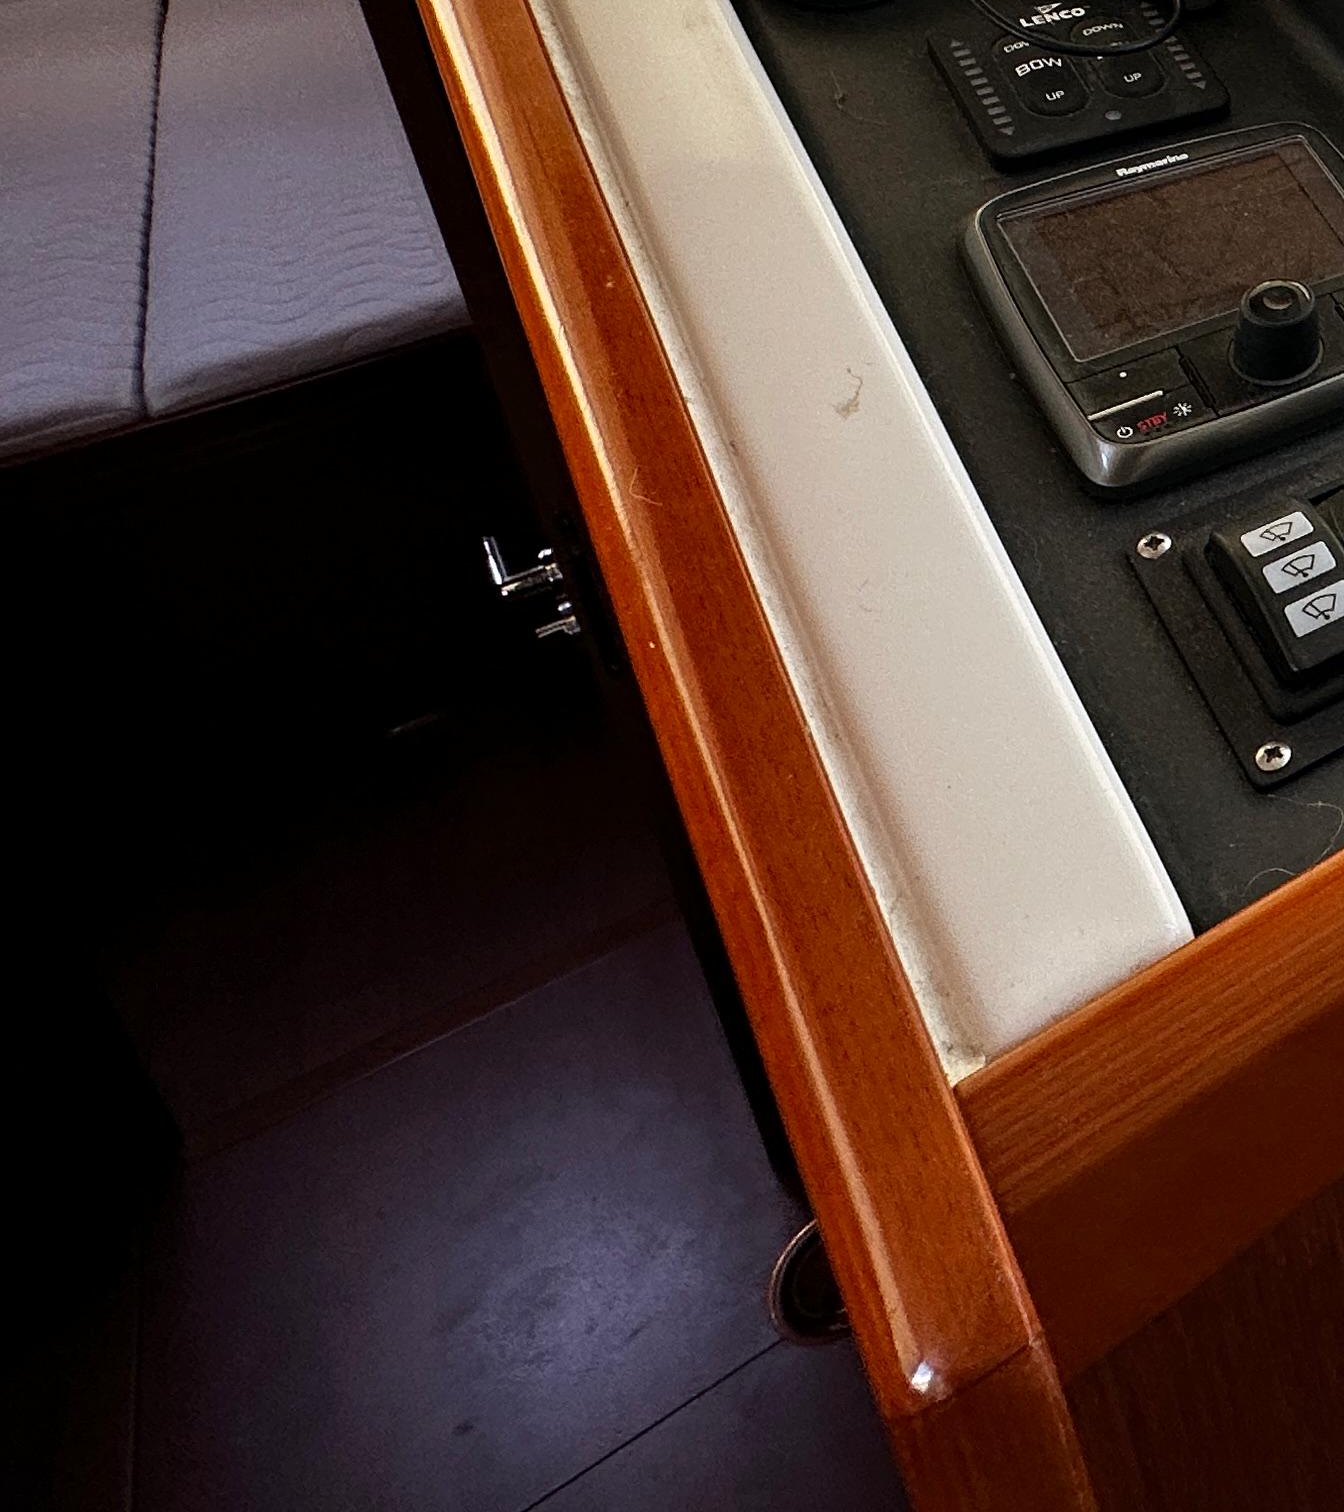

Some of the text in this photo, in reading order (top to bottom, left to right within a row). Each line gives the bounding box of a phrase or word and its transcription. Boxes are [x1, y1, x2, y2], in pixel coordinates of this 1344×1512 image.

[1019, 7, 1086, 28] LENCO
[1082, 21, 1124, 37] DOWN
[1015, 57, 1063, 78] BOW
[1123, 71, 1142, 84] UP
[1045, 89, 1065, 102] UP
[1115, 152, 1189, 177] Raymarine
[1136, 410, 1168, 433] STBY
